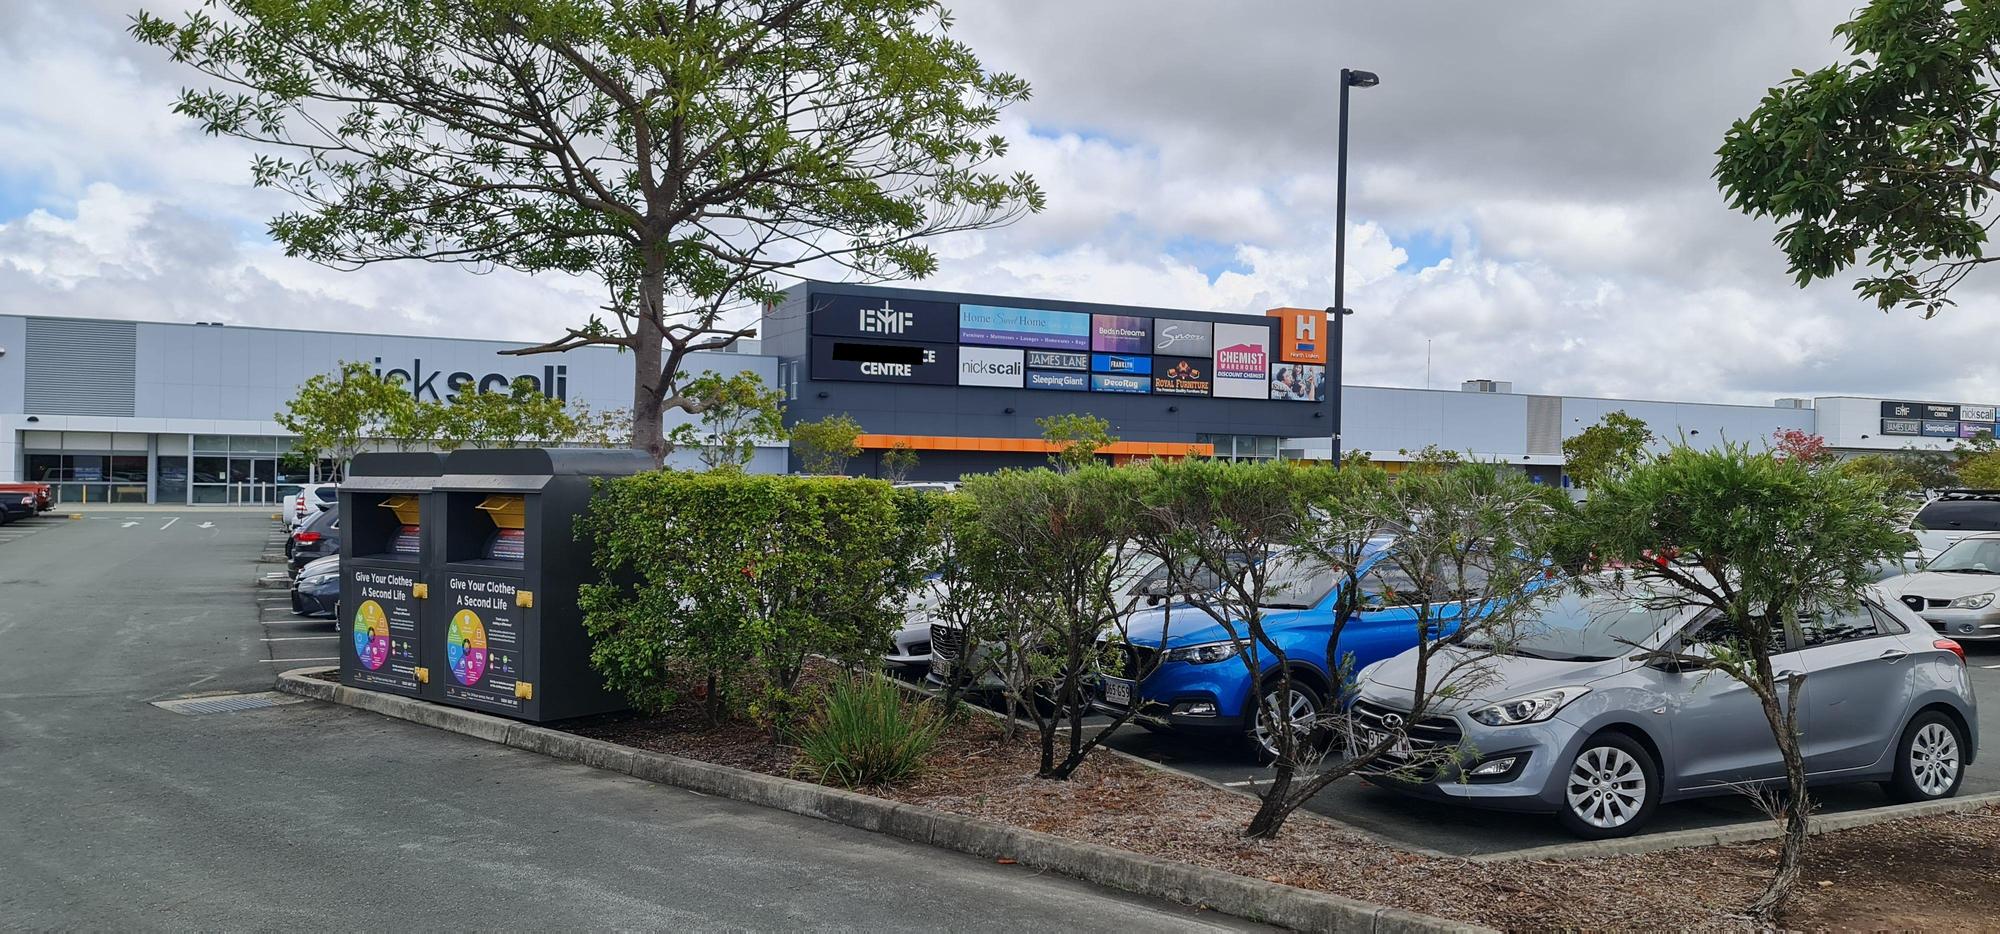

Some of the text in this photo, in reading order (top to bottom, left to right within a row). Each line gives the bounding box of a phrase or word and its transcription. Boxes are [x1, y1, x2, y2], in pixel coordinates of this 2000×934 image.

[860, 301, 913, 335] EMF
[963, 311, 991, 323] Home
[1019, 315, 1046, 327] Home
[1296, 315, 1316, 340] H
[1029, 354, 1087, 367] JAMES LANE
[1220, 351, 1264, 364] CHEMIST
[860, 362, 911, 376] CENTRE
[342, 357, 567, 407] ckscali
[1104, 379, 1138, 389] DecoRug
[1155, 377, 1208, 390] ROYAL FURNITURE
[1887, 423, 1903, 432] JAMES
[355, 572, 413, 587] Give Your Clothes
[362, 587, 406, 601] A Second Life
[450, 579, 516, 595] Give Your Clothes
[457, 595, 508, 610] A Second Life
